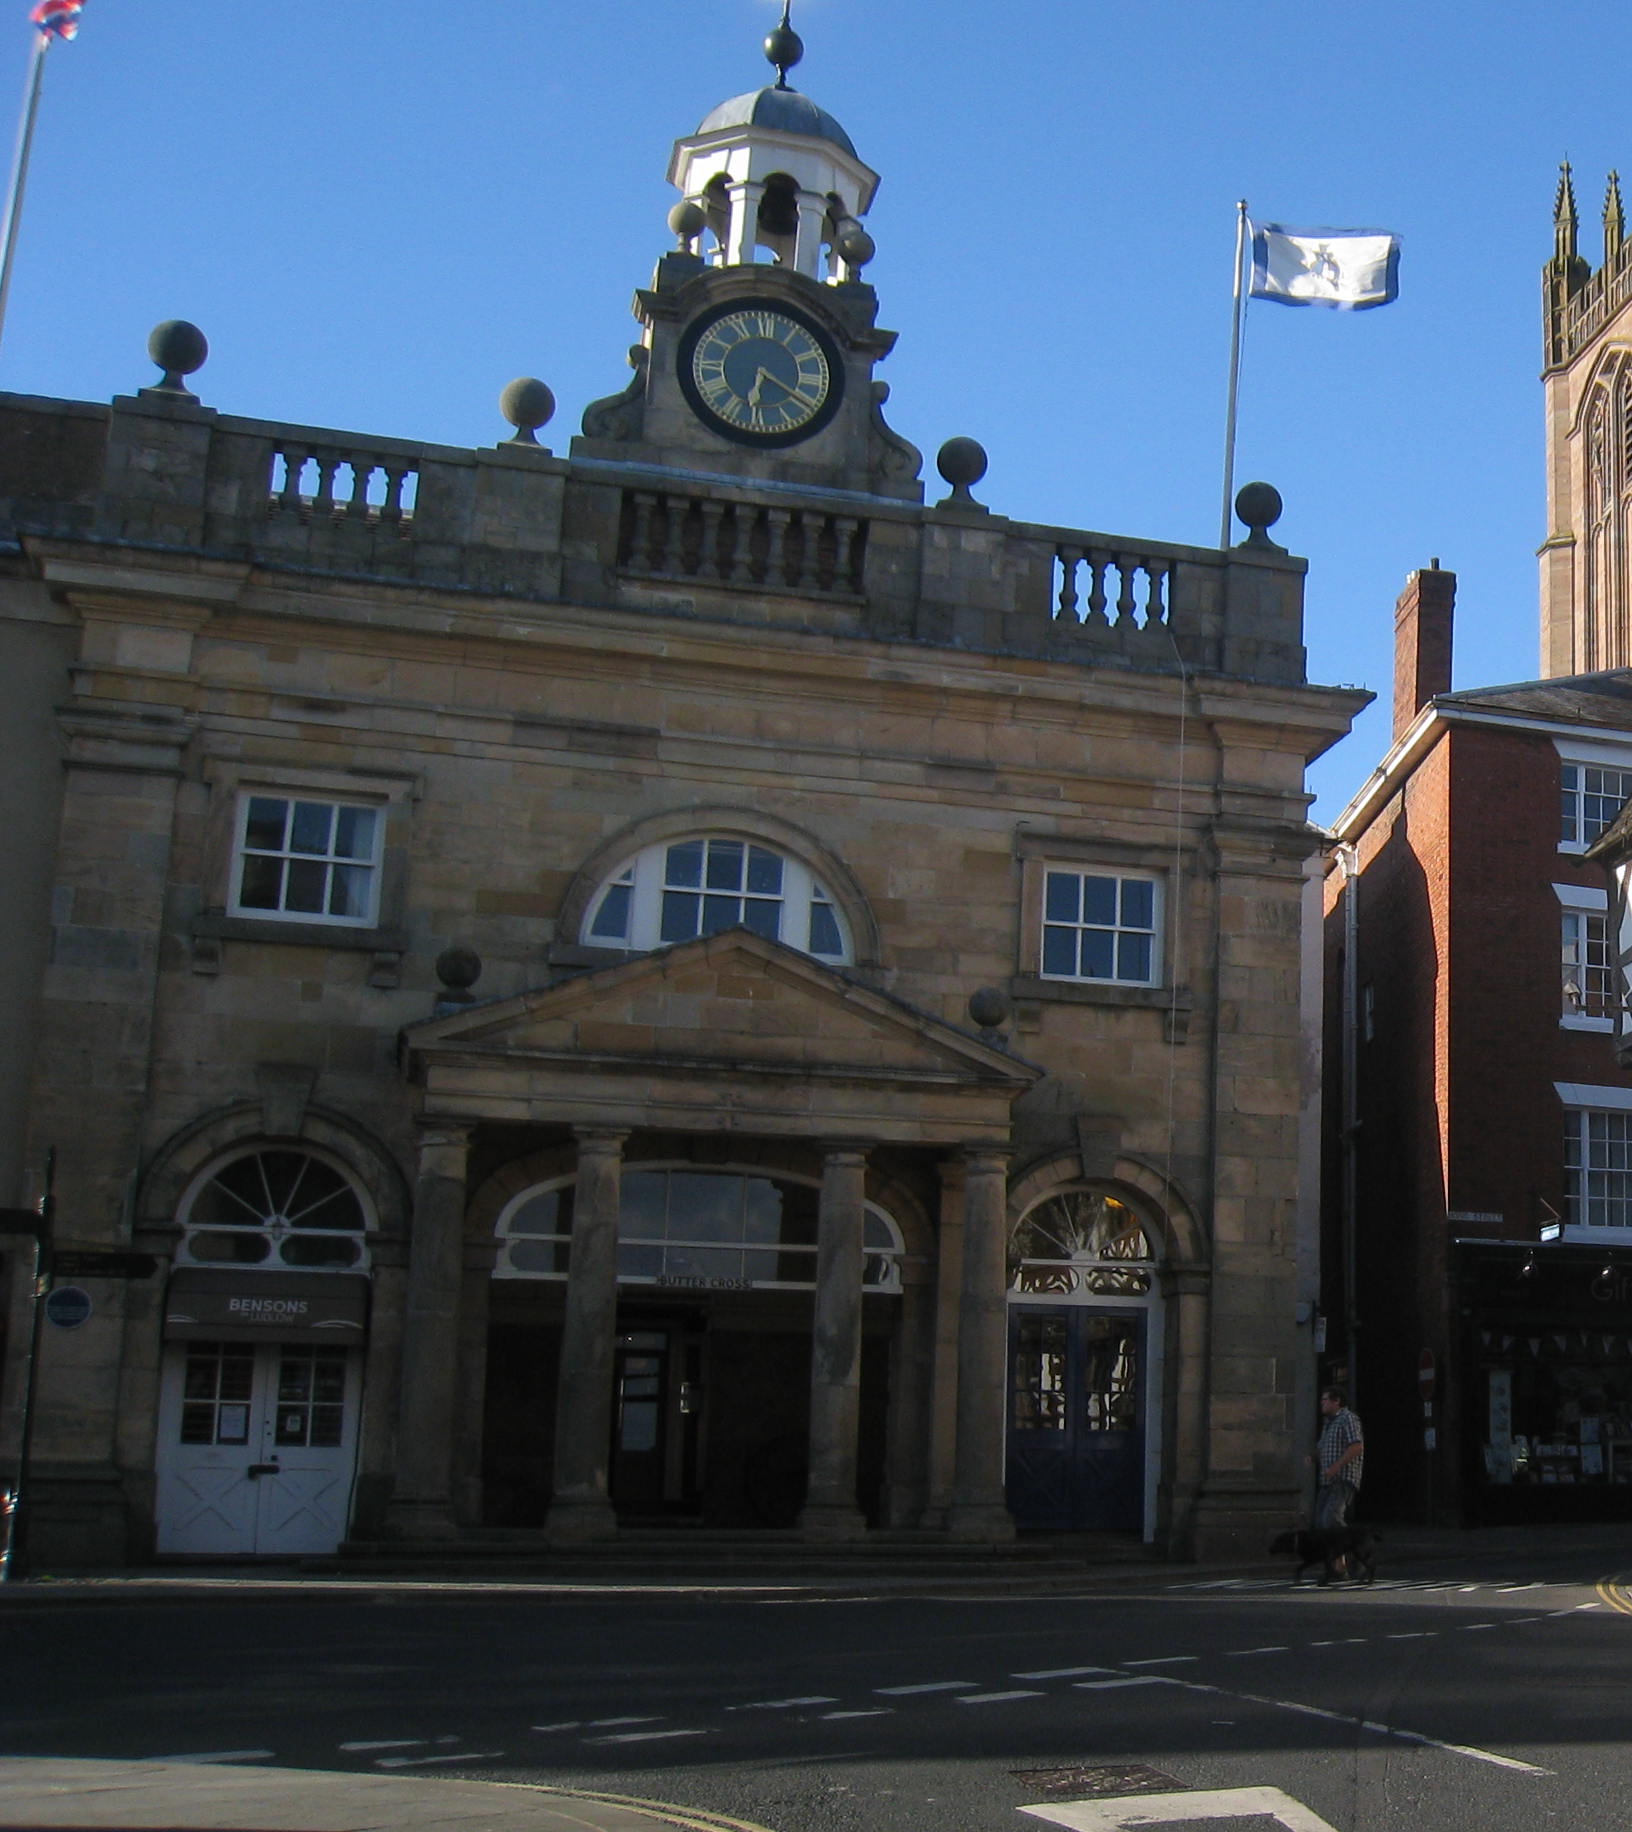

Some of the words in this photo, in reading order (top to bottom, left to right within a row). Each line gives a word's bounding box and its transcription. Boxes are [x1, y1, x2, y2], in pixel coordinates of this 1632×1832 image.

[660, 1275, 707, 1288] BUTTER
[711, 1278, 750, 1289] CROSS
[229, 1298, 309, 1313] BENSONS
